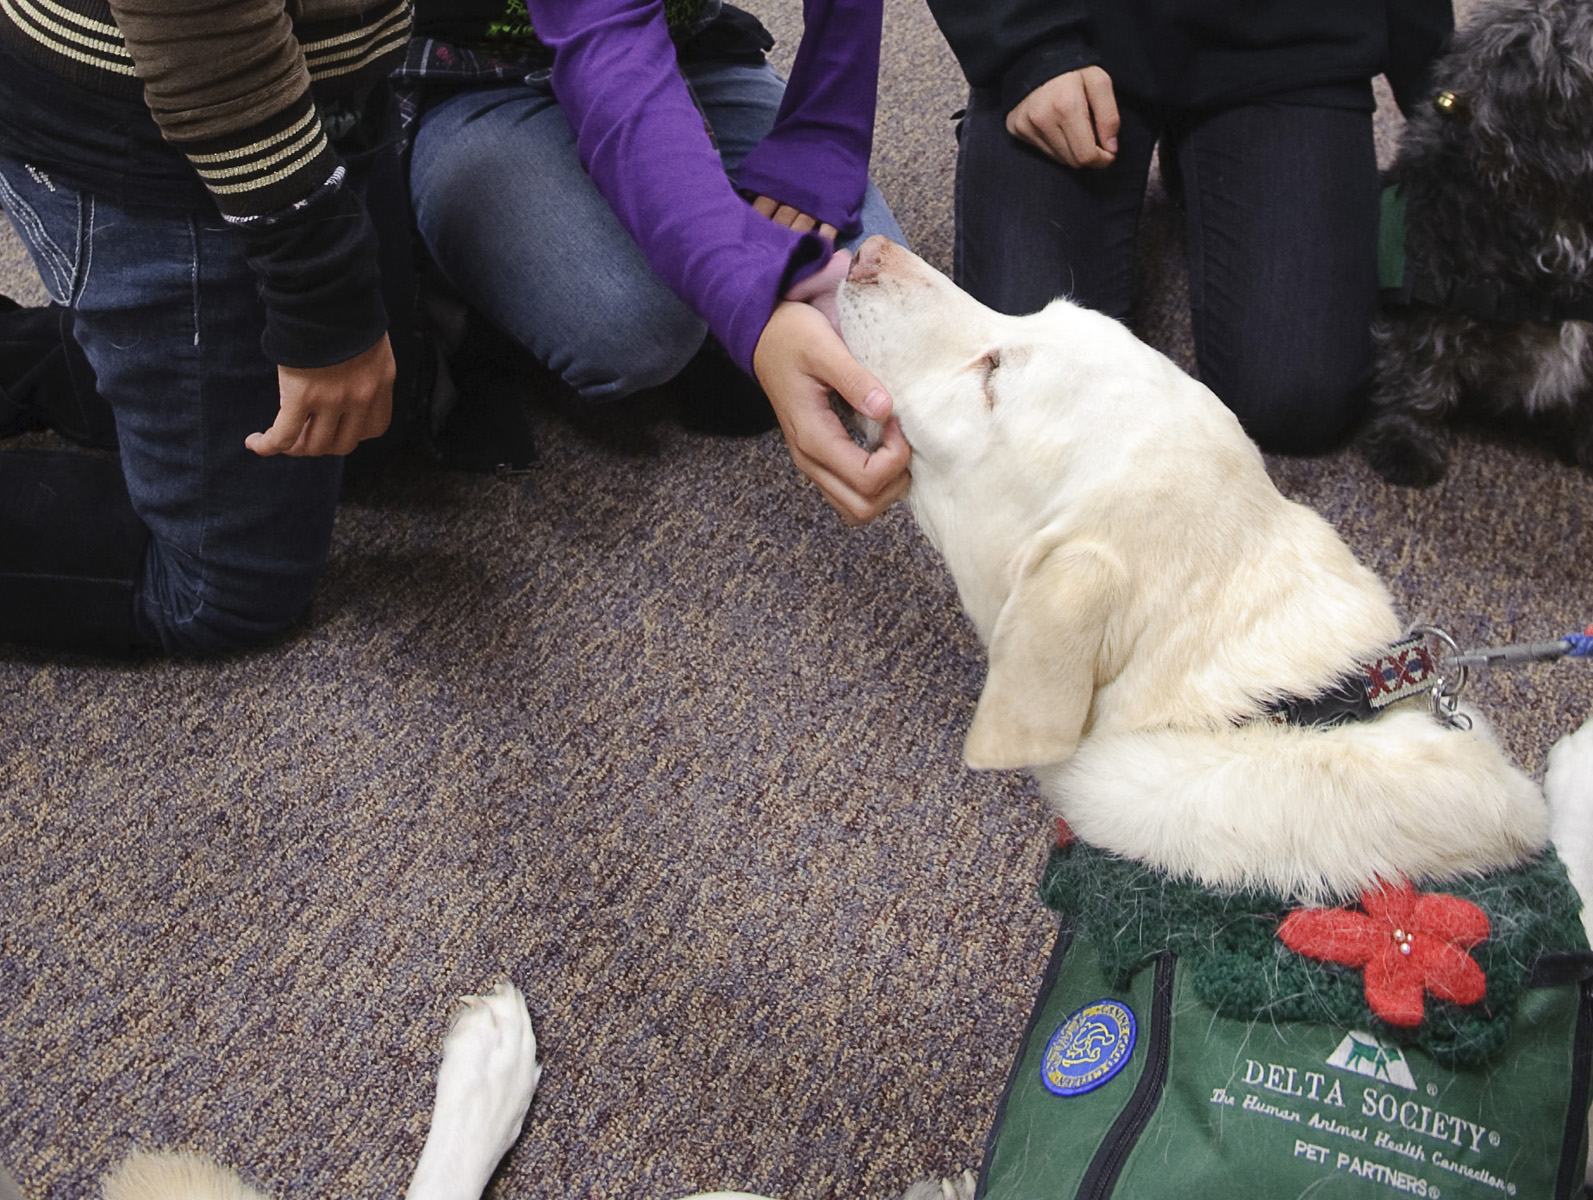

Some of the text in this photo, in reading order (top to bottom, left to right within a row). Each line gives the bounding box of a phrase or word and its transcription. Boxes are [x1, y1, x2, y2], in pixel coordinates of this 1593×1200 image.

[1241, 1058, 1346, 1108] DELTA
[1209, 1088, 1236, 1106] The
[1242, 1093, 1301, 1122] Human
[1307, 1112, 1369, 1143] Animal
[1374, 1130, 1427, 1163] Health
[1293, 1139, 1330, 1164] PET
